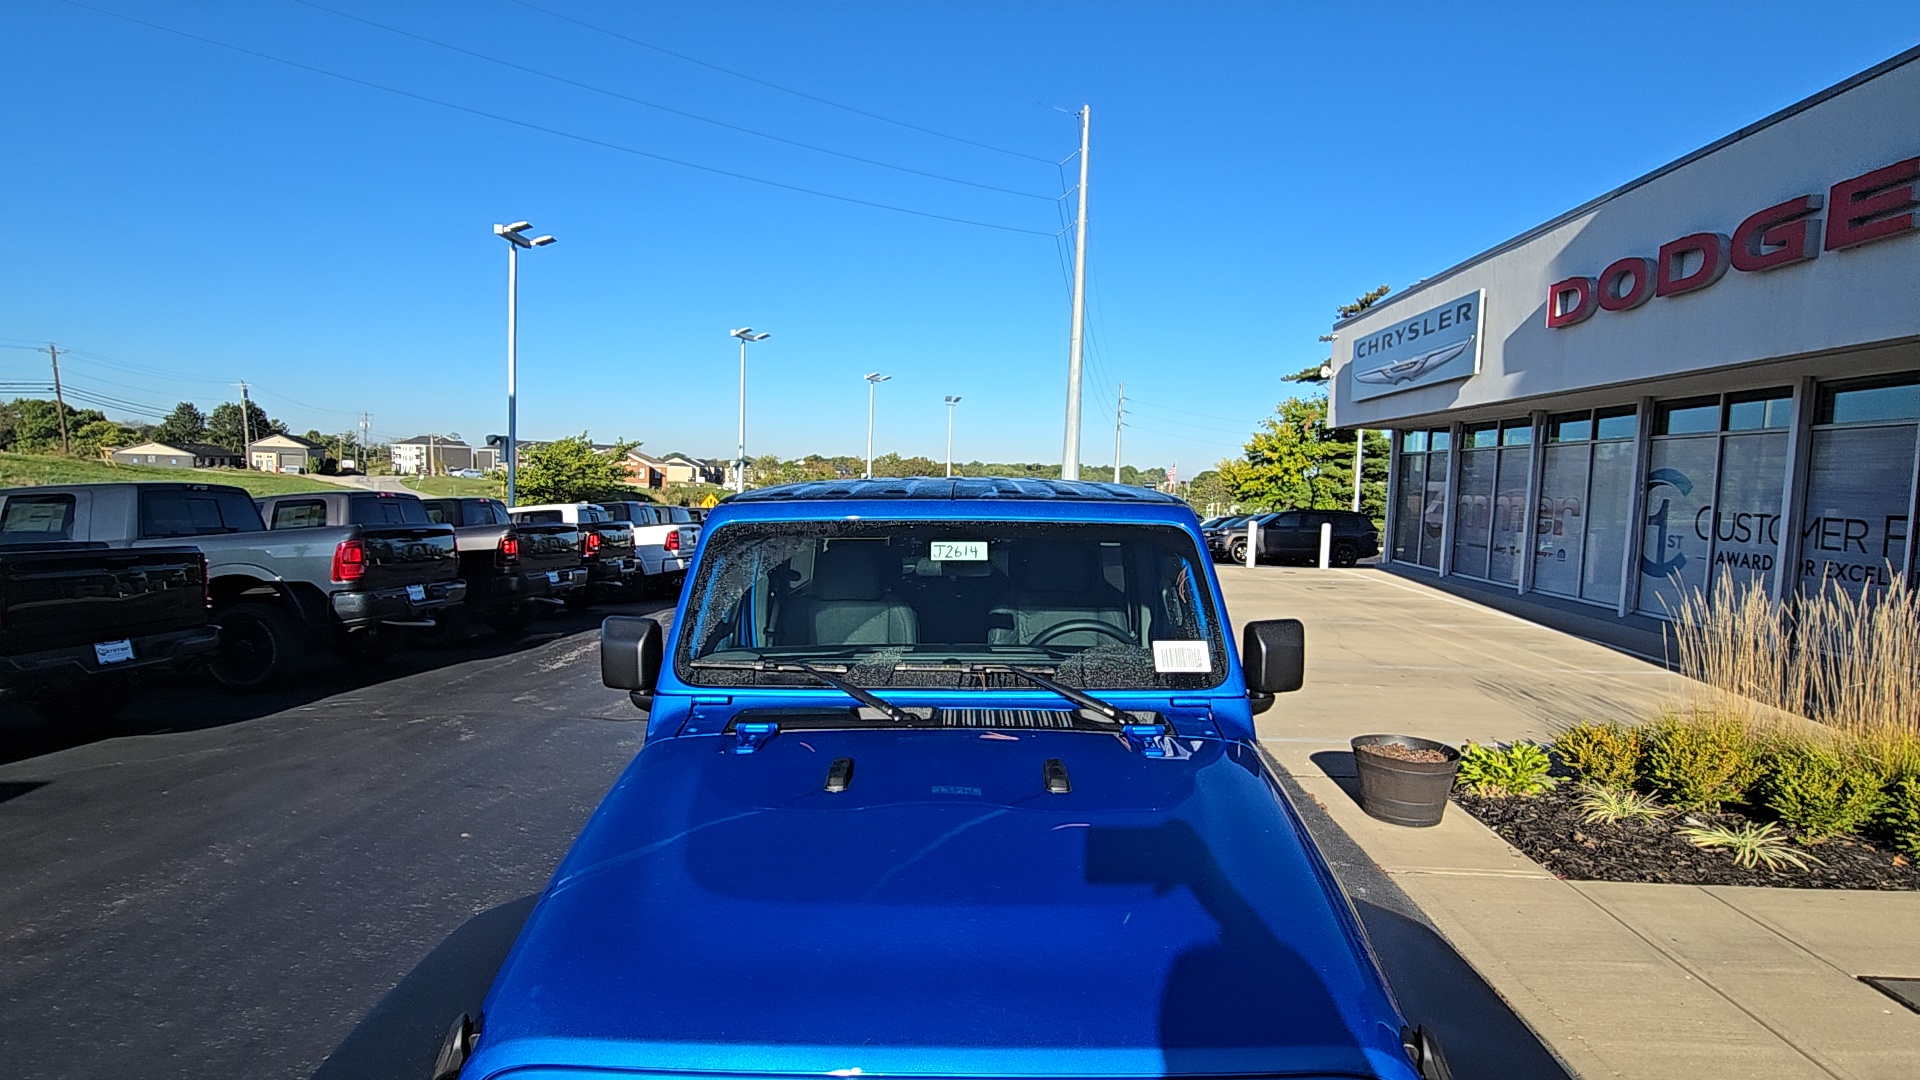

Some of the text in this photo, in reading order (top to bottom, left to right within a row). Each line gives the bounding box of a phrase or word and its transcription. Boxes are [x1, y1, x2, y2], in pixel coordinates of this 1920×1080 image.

[1547, 156, 1920, 329] DODGE
[1357, 302, 1472, 359] CHRYSLER
[933, 544, 978, 559] J2614
[1715, 550, 1774, 572] AWARD
